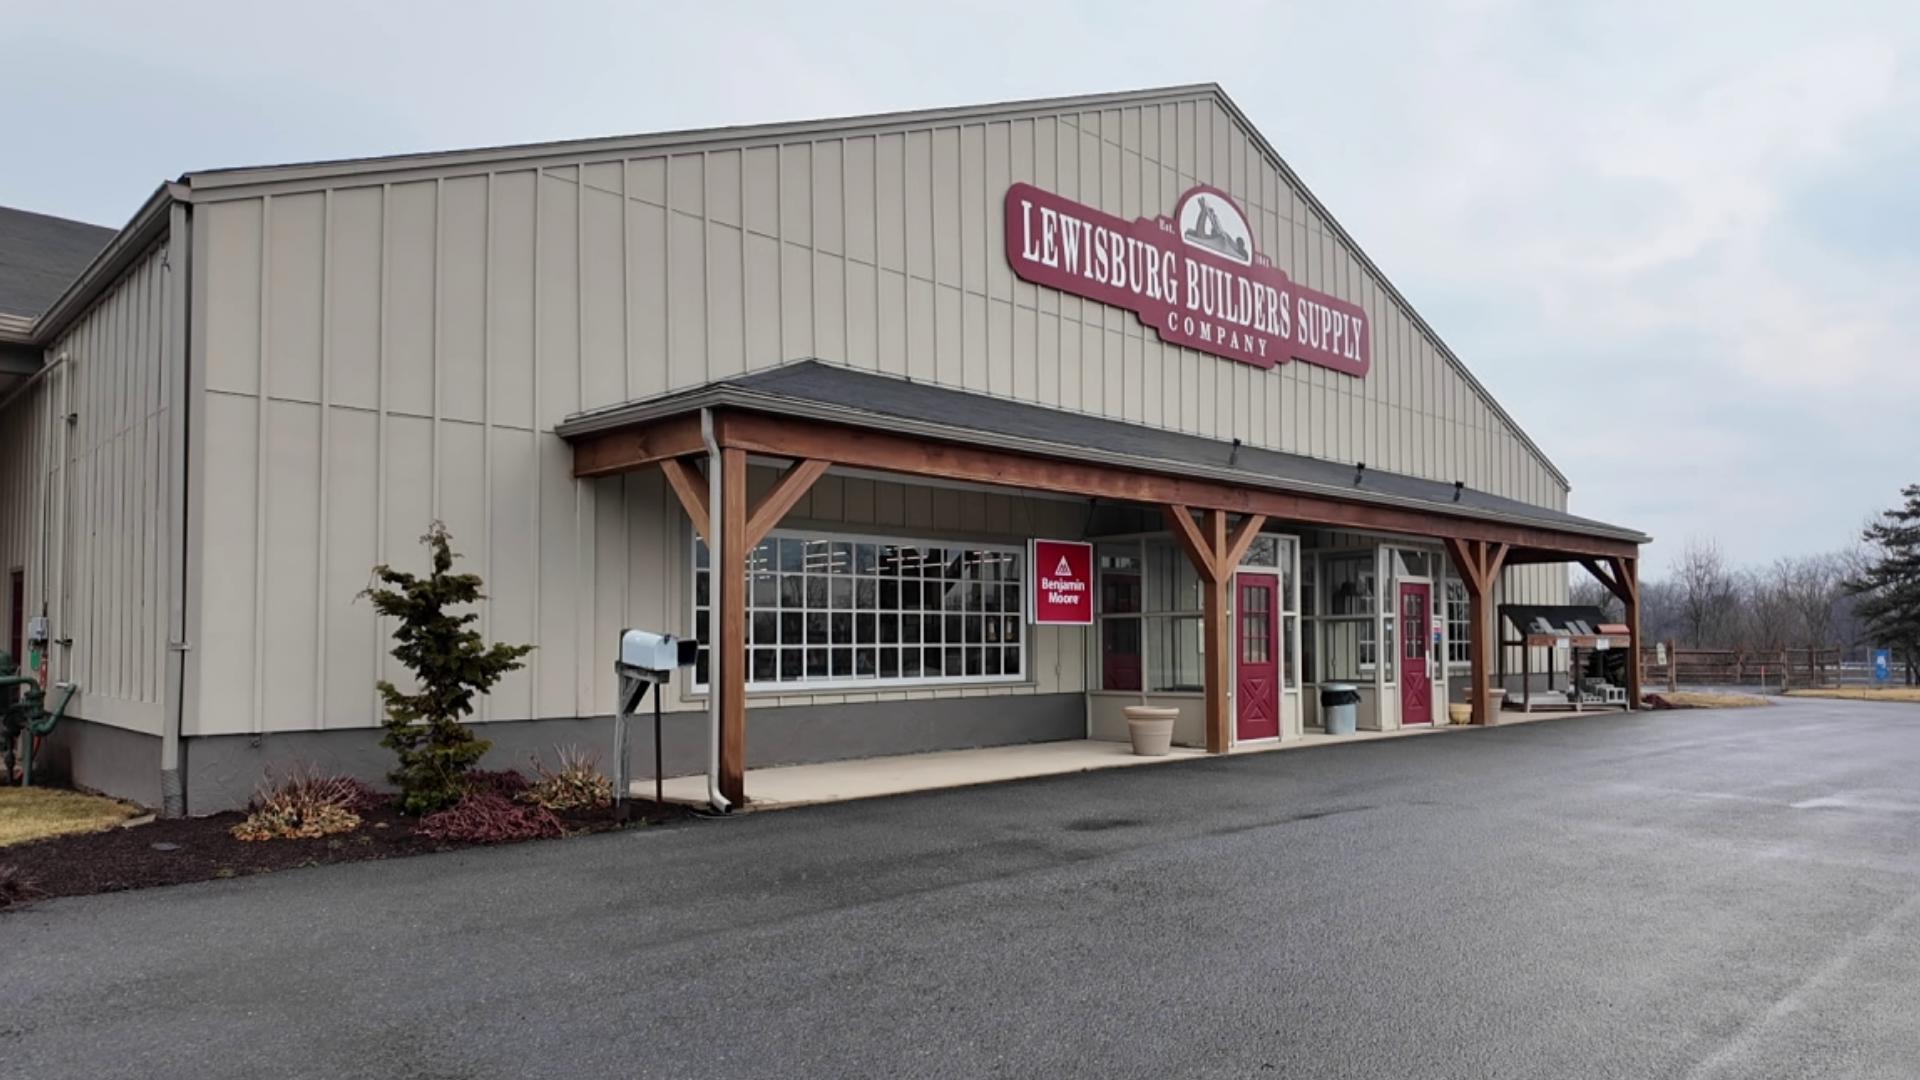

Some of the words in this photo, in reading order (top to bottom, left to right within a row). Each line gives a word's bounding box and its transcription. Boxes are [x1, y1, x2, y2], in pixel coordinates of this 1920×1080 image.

[1021, 200, 1178, 305] LEWISBURG
[1186, 259, 1290, 339] BUILDERS
[1297, 298, 1363, 361] SUPPLY
[1168, 312, 1267, 357] COMPANY
[1041, 577, 1085, 592] Benjamin
[1048, 592, 1079, 605] Moore
